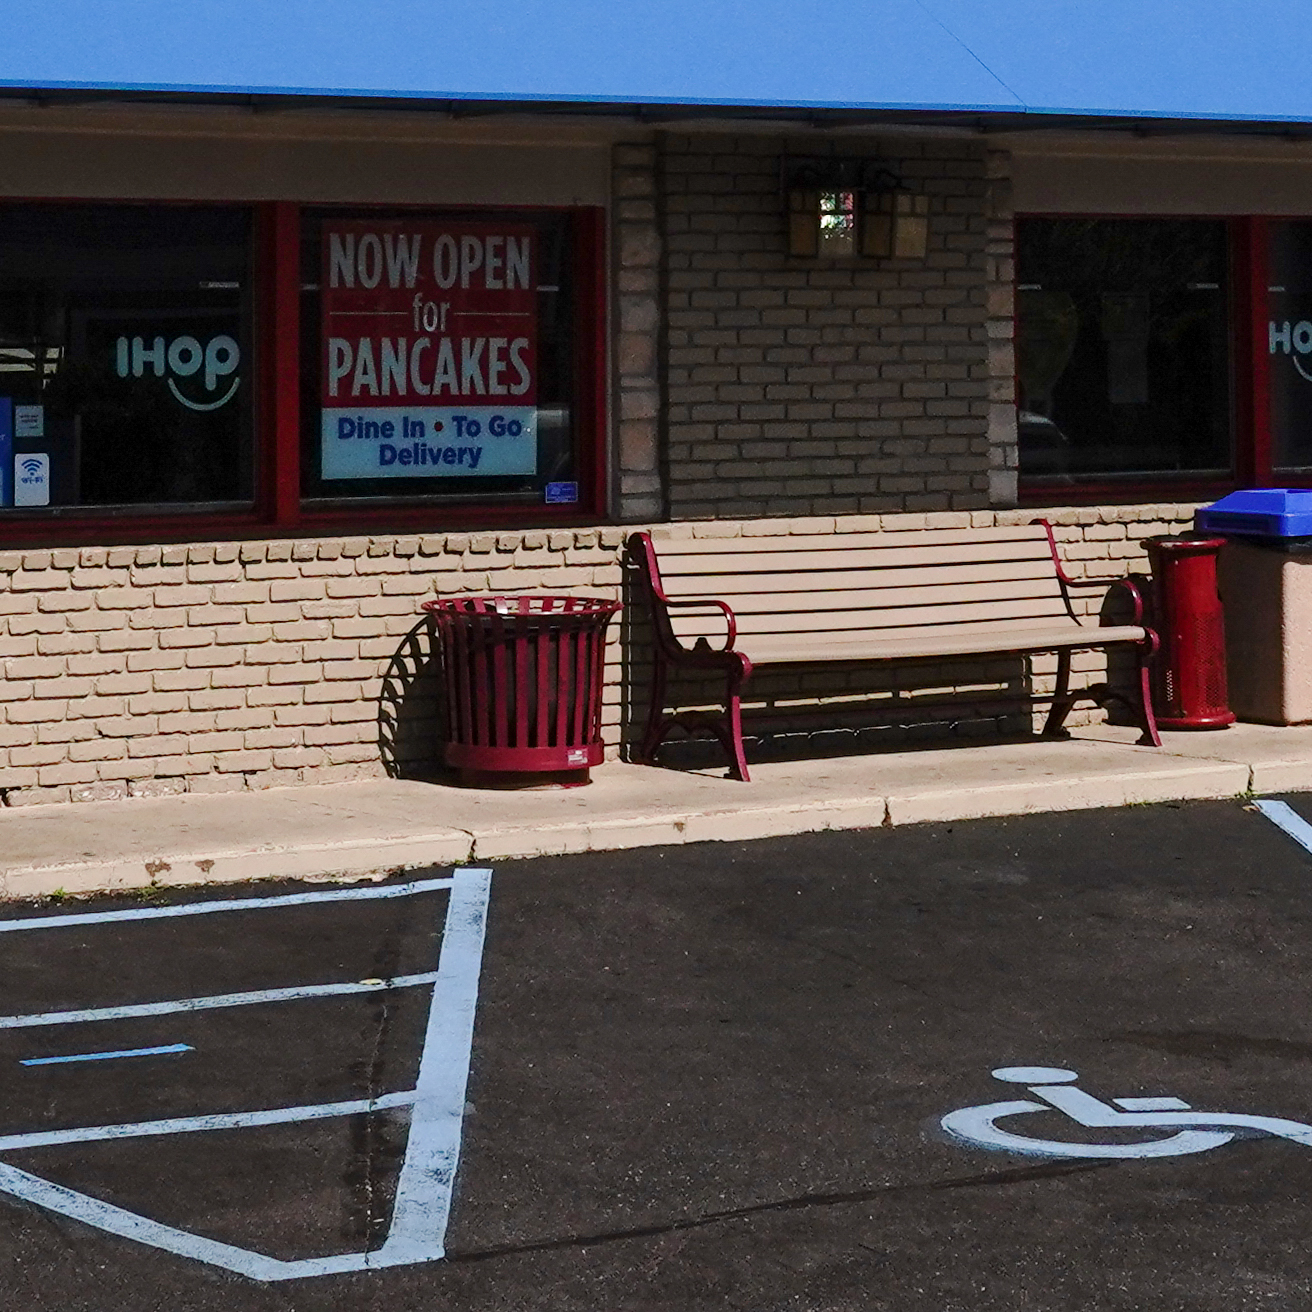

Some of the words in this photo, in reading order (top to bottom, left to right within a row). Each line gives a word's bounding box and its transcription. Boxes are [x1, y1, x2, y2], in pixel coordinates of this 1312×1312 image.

[329, 233, 422, 289] NOW
[433, 233, 530, 290] OPEN
[412, 292, 450, 332] for
[328, 337, 532, 397] PANCAKES
[337, 415, 395, 440] Dine
[403, 415, 426, 438] In
[452, 415, 482, 437] To
[488, 414, 523, 437] Go
[379, 443, 483, 468] Delivery
